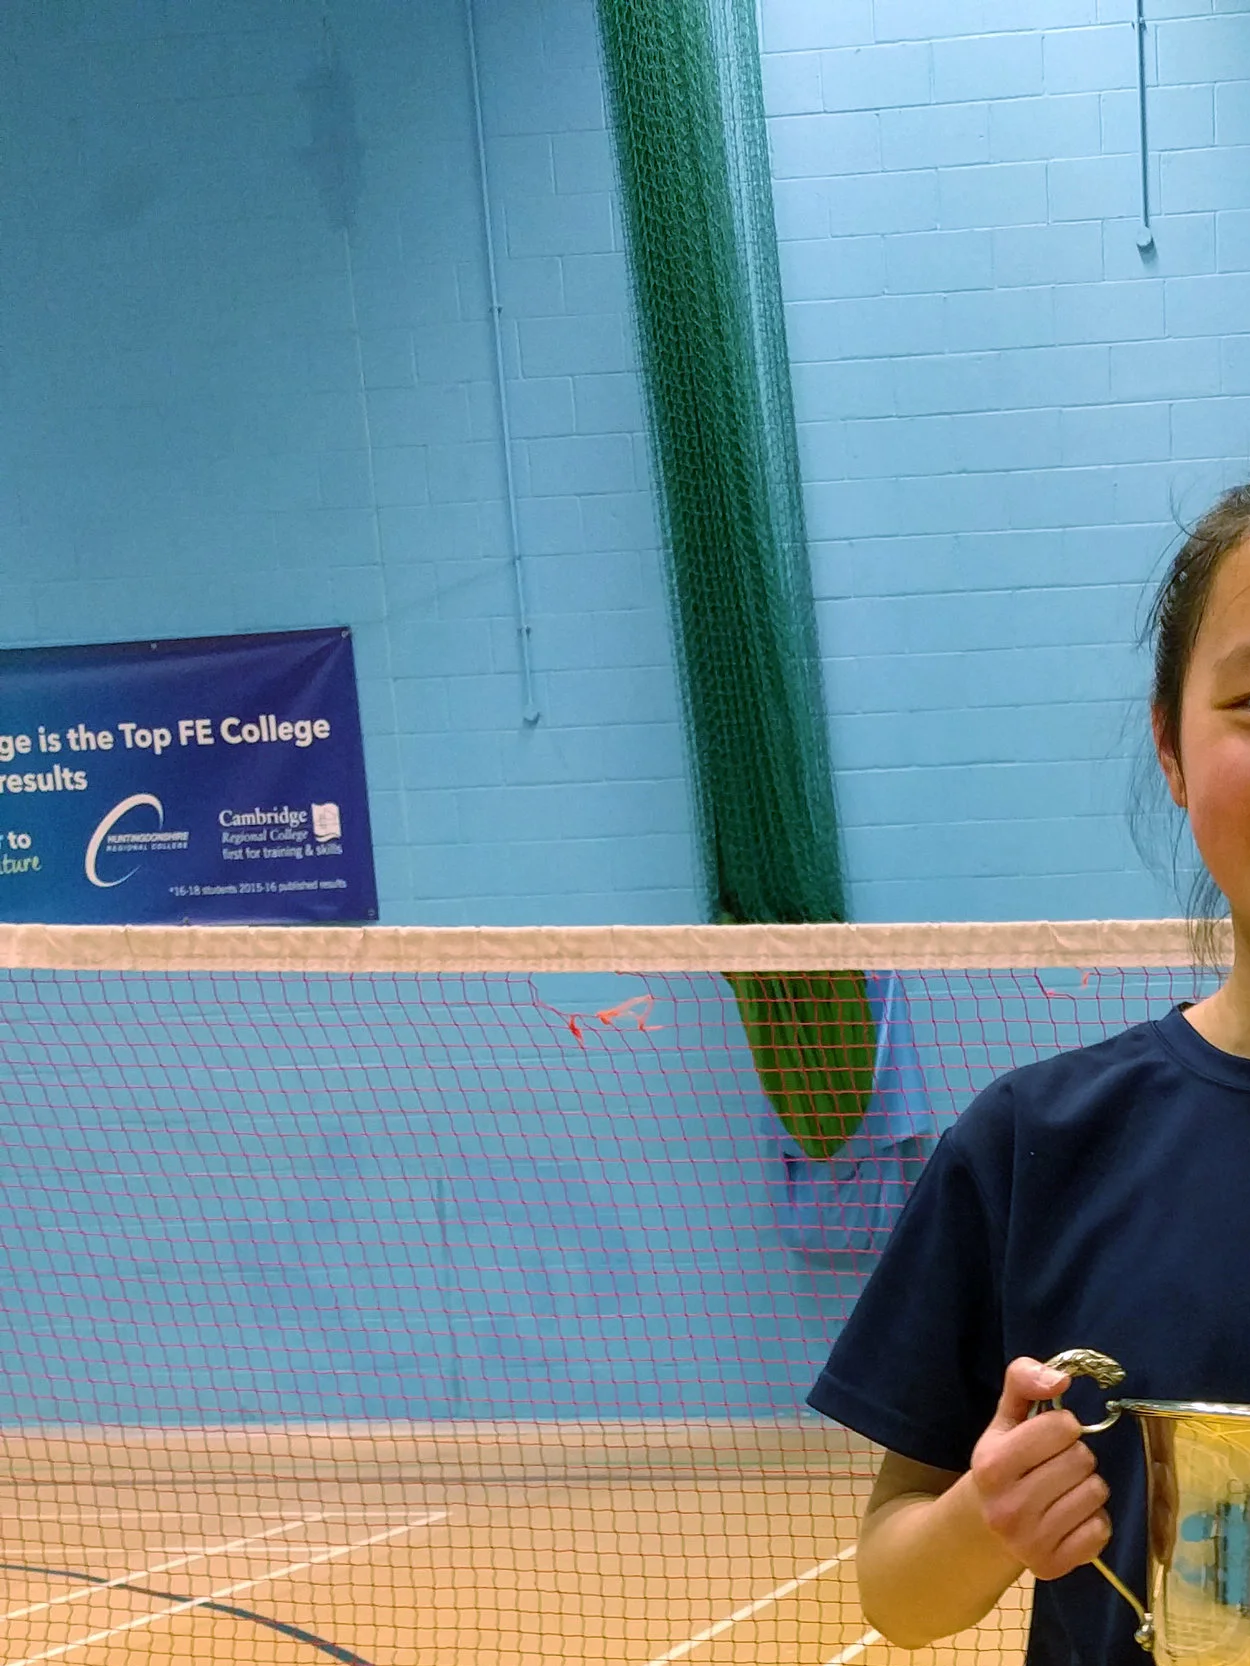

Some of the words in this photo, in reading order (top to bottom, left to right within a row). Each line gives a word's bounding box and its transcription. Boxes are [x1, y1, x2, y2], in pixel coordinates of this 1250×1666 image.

[38, 726, 62, 752] is
[67, 723, 113, 751] the
[118, 723, 172, 754] Top
[179, 719, 214, 745] FE
[220, 715, 330, 747] College
[0, 763, 88, 793] results
[219, 806, 308, 827] Cambridge
[7, 831, 31, 849] to
[151, 841, 188, 850] COLLEGE
[222, 829, 267, 845] Regional
[270, 828, 308, 842] College
[245, 847, 260, 858] for
[263, 845, 303, 859] training
[305, 844, 314, 857] &
[0, 853, 42, 874] ture
[239, 882, 277, 894] 2015-16
